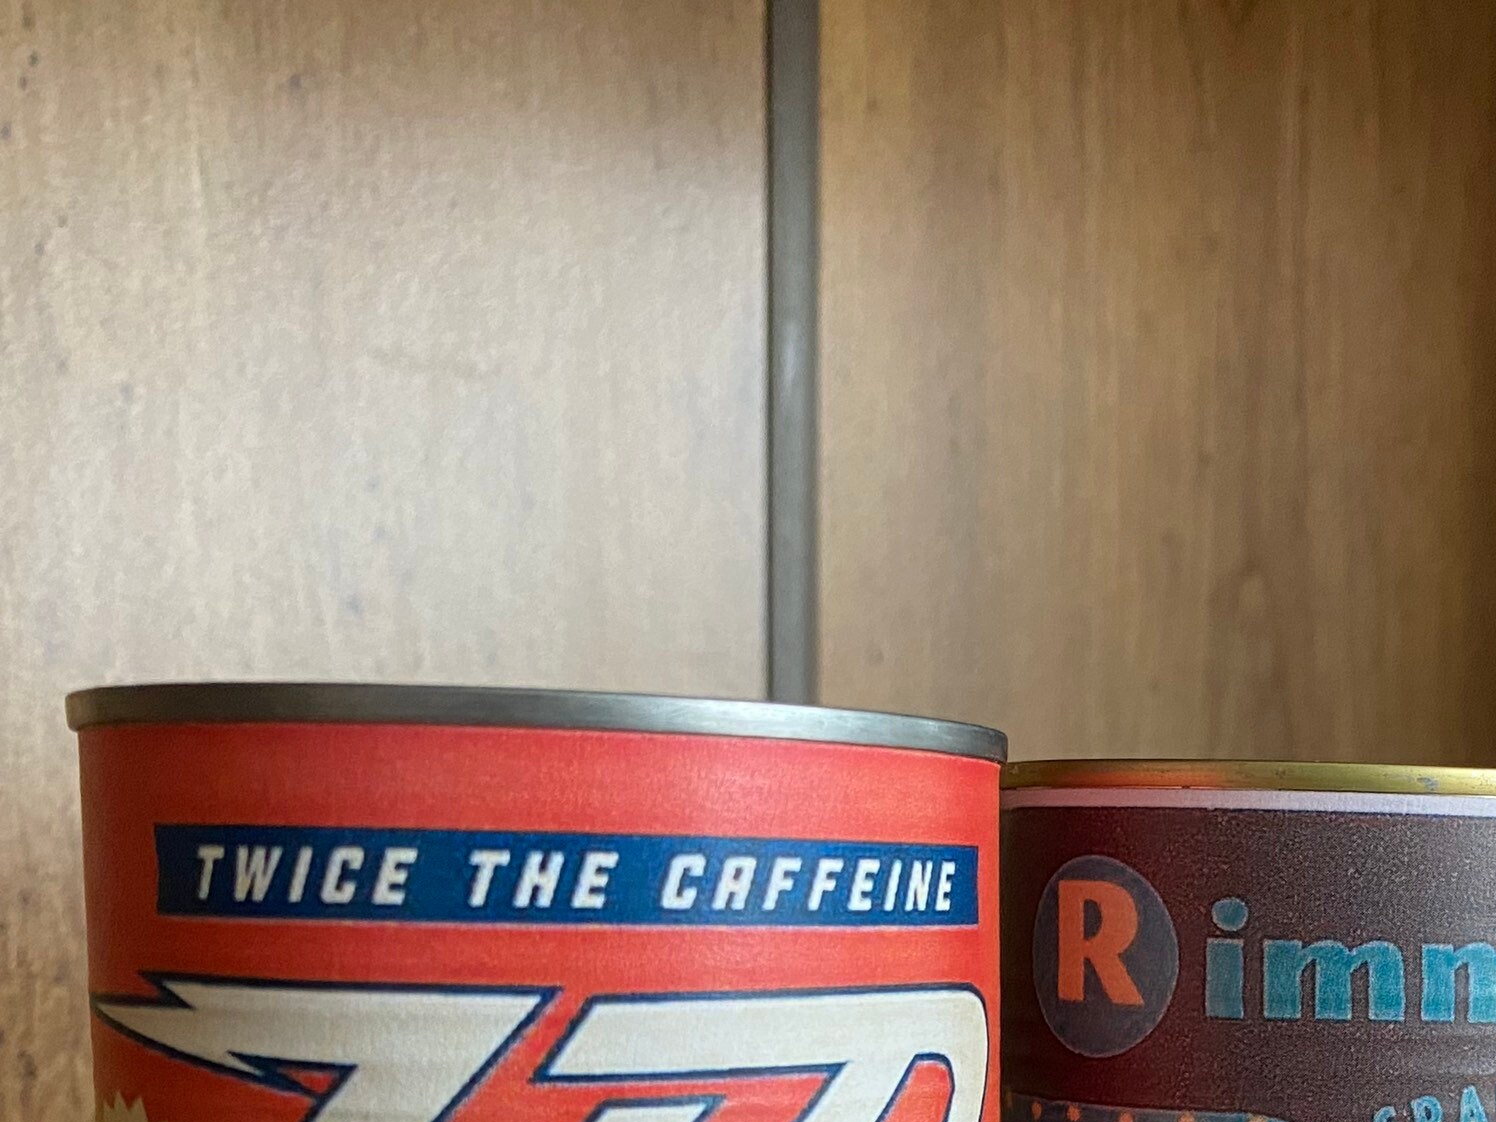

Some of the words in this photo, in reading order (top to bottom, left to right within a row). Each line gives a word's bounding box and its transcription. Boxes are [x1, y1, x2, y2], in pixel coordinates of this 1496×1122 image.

[195, 845, 417, 906] TWICE
[469, 850, 620, 909] THE
[660, 856, 958, 914] CAFFEINE
